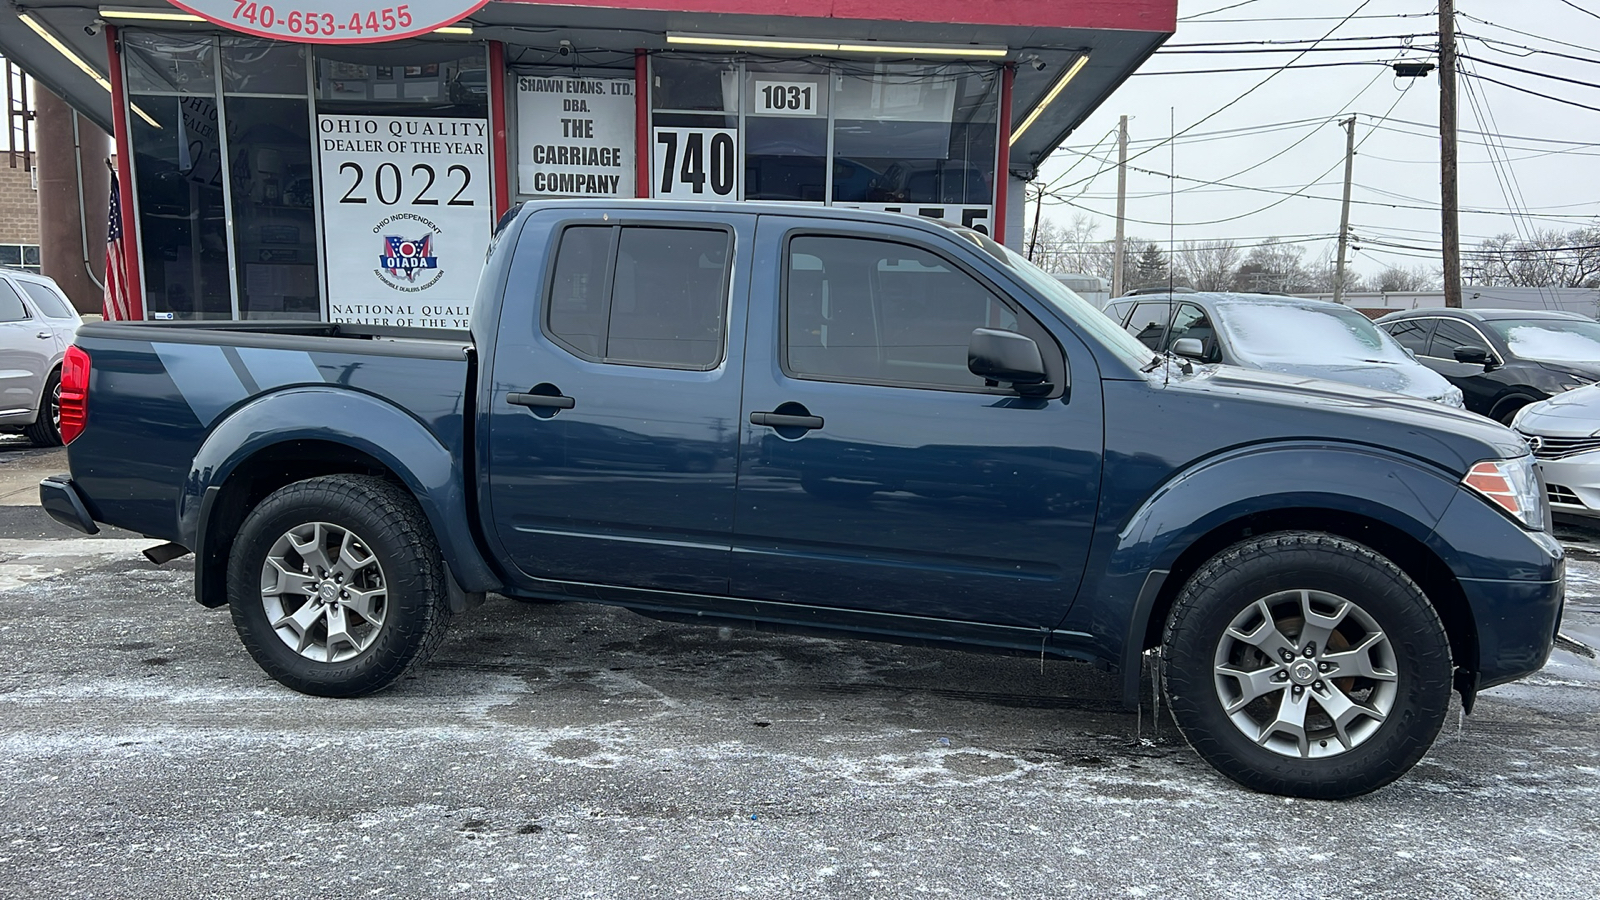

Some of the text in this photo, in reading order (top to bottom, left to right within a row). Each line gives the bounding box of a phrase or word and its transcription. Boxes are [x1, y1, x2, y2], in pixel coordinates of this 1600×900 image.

[232, 0, 412, 36] 740-653-4455
[520, 78, 633, 96] SHAWN EVANS. LTD.
[563, 99, 591, 113] DBA.
[762, 85, 811, 110] 1031
[320, 119, 486, 138] OHIO QUALITY
[560, 118, 594, 138] THE
[323, 139, 484, 155] DEALER OF THE YEAR
[533, 144, 621, 167] CARRIAGE
[657, 132, 734, 196] 740
[339, 161, 475, 206] 2022
[534, 172, 620, 194] COMPANY
[372, 213, 442, 234] OHIO INDEPENDENT
[387, 257, 428, 268] OIADA
[420, 269, 445, 291] ASSOCIATION
[333, 304, 470, 316] NATIONAL QUALI
[335, 317, 469, 328] DEALER OF THE YE
